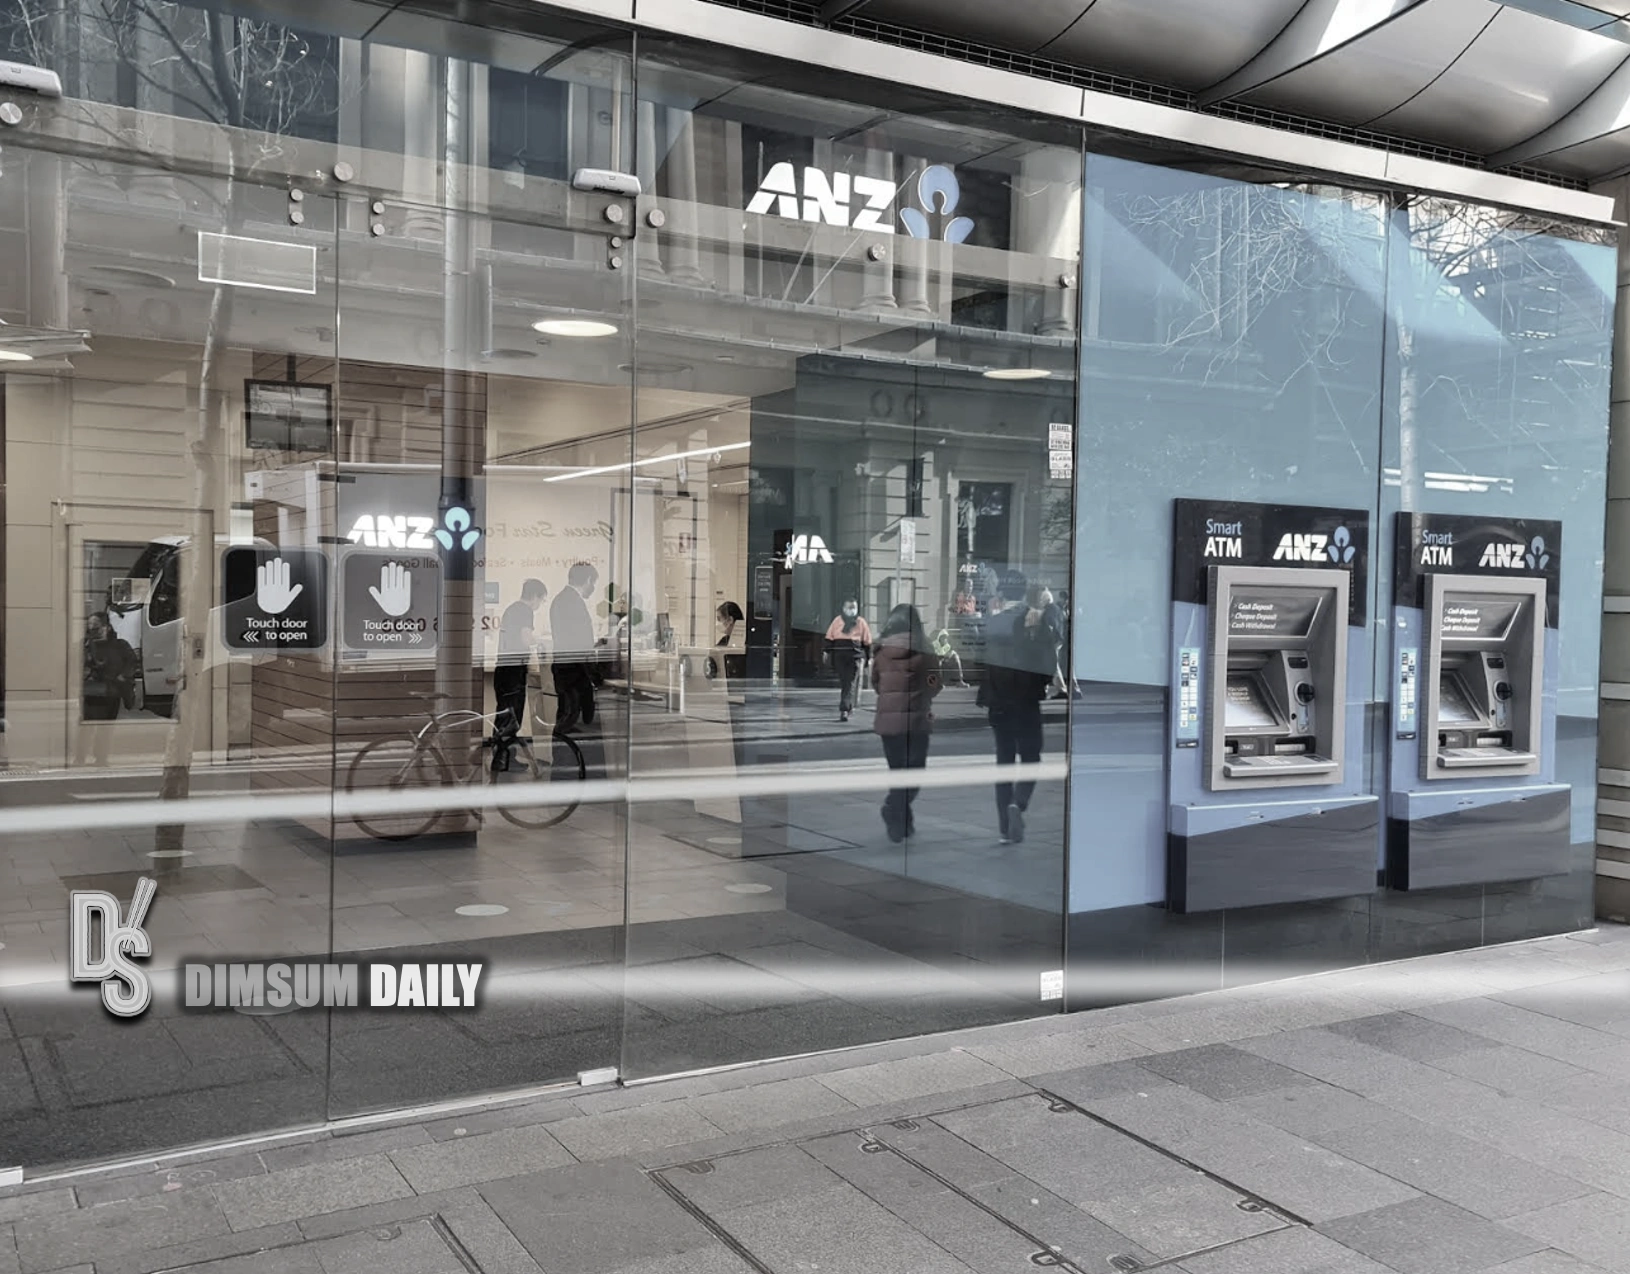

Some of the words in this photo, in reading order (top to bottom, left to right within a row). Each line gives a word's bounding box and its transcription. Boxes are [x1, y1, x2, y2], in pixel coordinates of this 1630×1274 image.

[745, 161, 897, 234] ANZ
[346, 514, 434, 549] ANZ
[1206, 518, 1242, 536] Smart
[1422, 529, 1453, 545] Smart
[1204, 537, 1242, 558] ATM
[1272, 533, 1328, 562] ANZ
[1421, 546, 1453, 566] ATM
[1478, 543, 1526, 568] ANZ
[1252, 603, 1274, 611] Deposit
[246, 617, 279, 629] Touch
[281, 618, 308, 629] door
[363, 620, 394, 630] Touch
[395, 620, 421, 631] door
[265, 630, 277, 641] to
[279, 632, 308, 643] open
[363, 632, 373, 642] to
[375, 634, 402, 644] open
